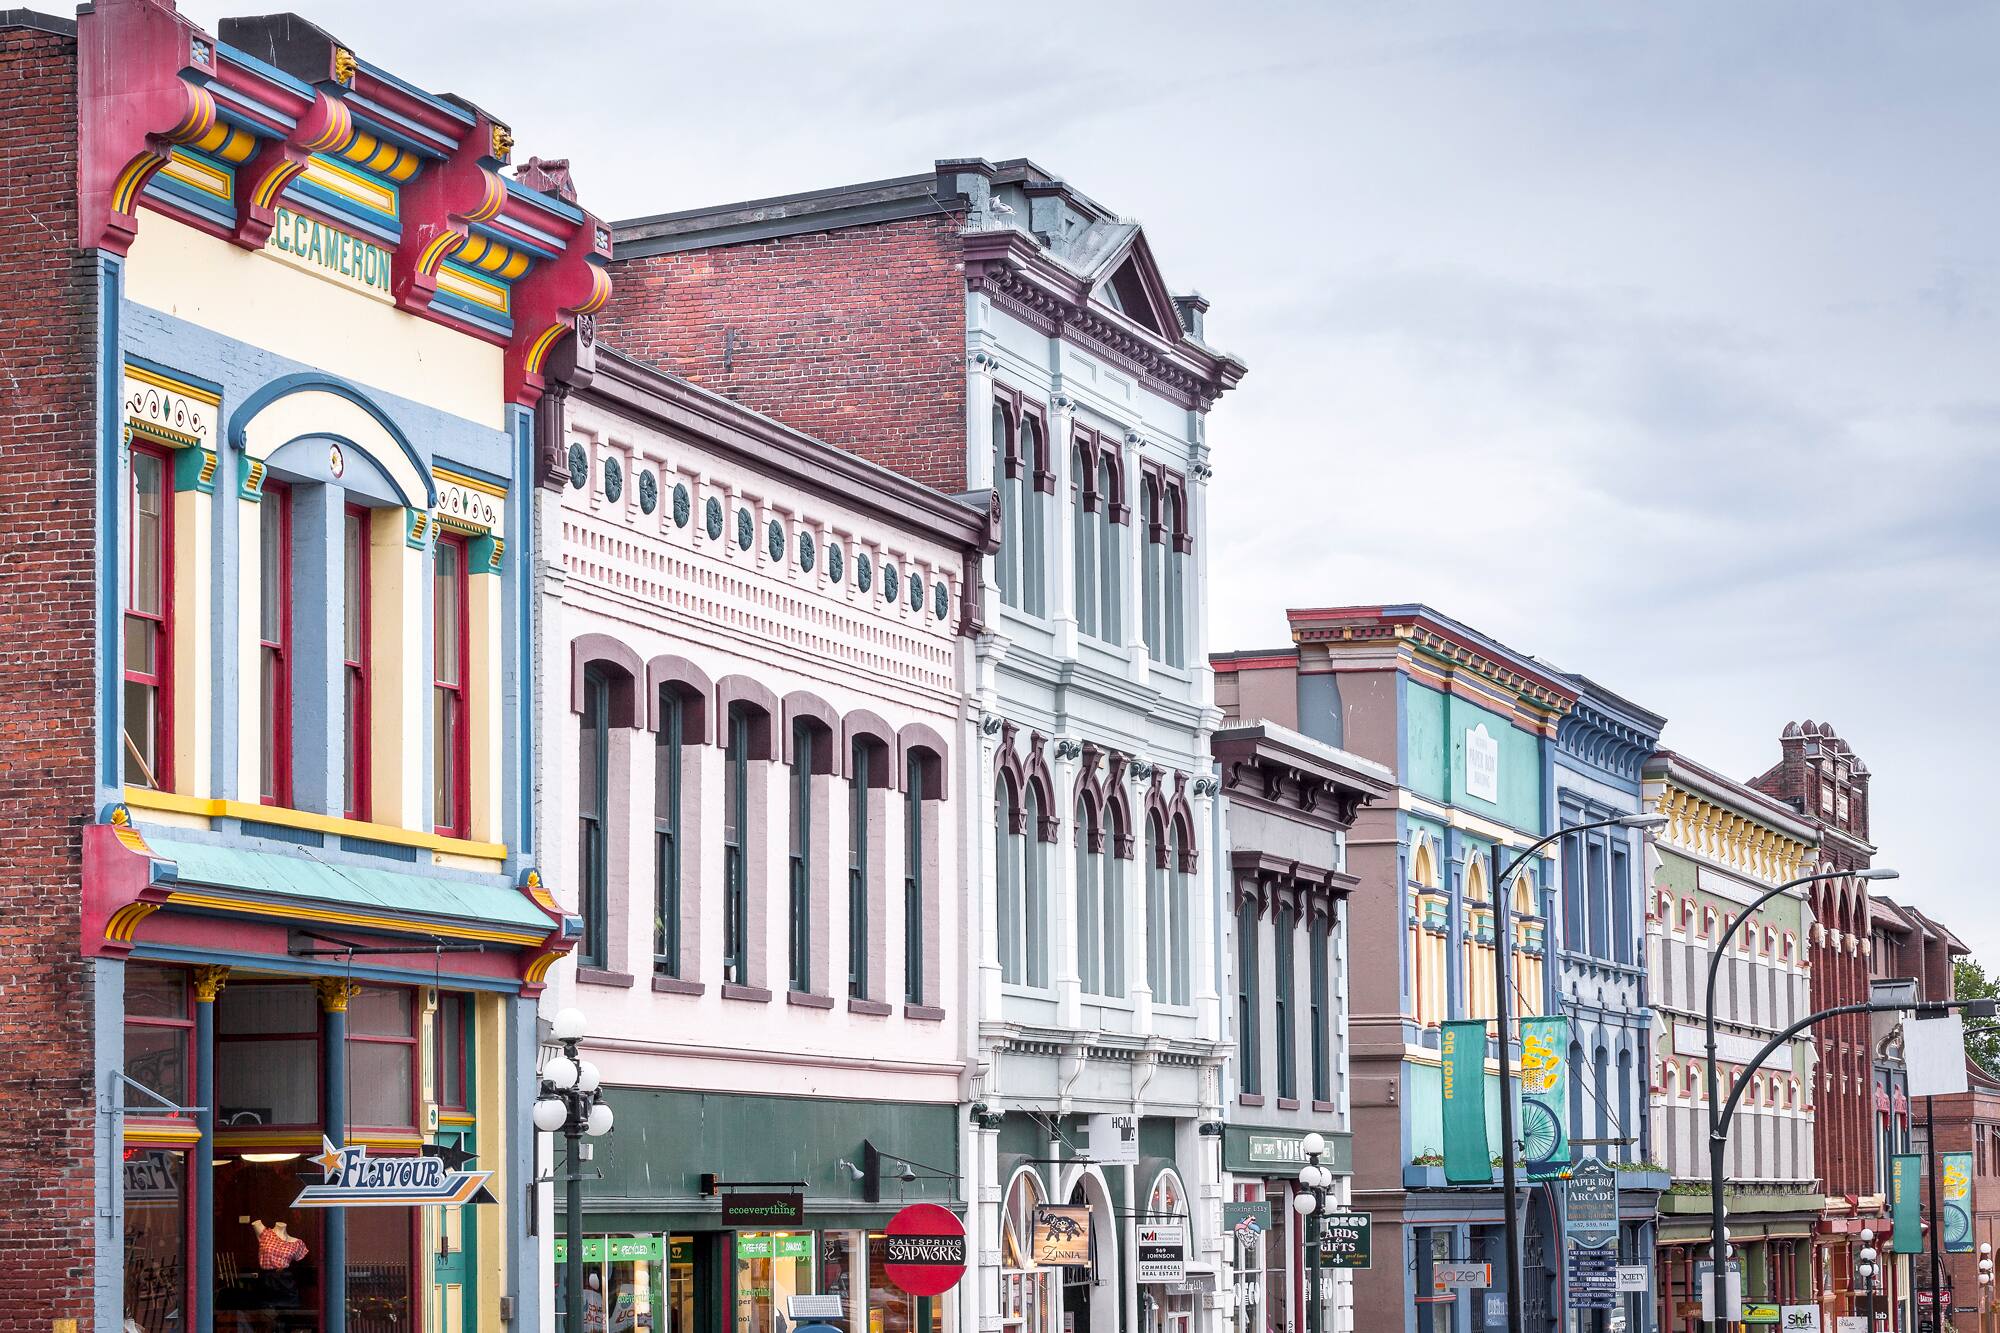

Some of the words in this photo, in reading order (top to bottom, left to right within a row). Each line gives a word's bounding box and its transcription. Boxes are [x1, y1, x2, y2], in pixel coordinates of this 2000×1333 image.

[339, 1149, 440, 1188] FLAVOUR
[1568, 1179, 1596, 1189] PAPER
[1598, 1177, 1614, 1187] BOX
[1569, 1191, 1615, 1201] ARCADE
[728, 1204, 796, 1217] ecoeverything
[1141, 1230, 1157, 1241] NAI
[888, 1238, 962, 1246] SALTSPRING
[888, 1246, 962, 1261] SOAPWORKS
[1875, 1311, 1887, 1320] lab
